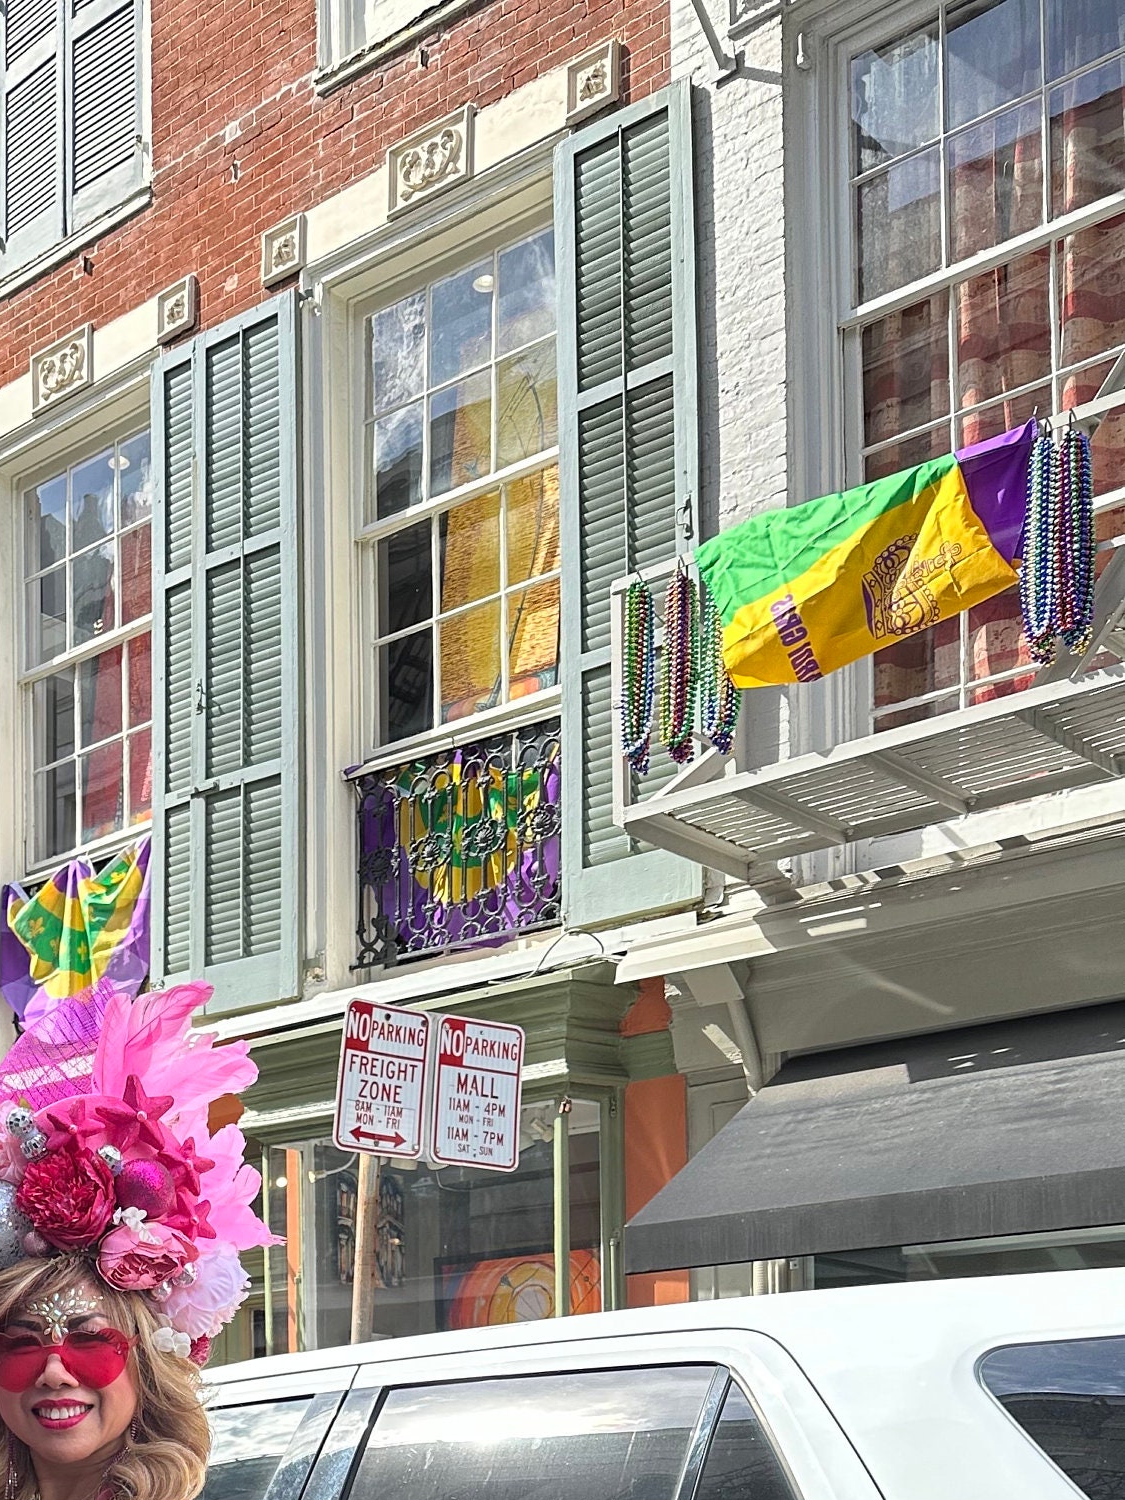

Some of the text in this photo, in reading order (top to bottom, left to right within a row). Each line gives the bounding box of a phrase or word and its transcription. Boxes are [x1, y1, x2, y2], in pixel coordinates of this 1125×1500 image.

[347, 1010, 424, 1047] NO PARKING
[440, 1028, 518, 1061] NO PARKING
[349, 1054, 418, 1083] FREIGHT
[358, 1079, 402, 1104] ZONE
[456, 1072, 499, 1099] MALL
[355, 1100, 372, 1113] 8AM
[384, 1105, 403, 1118] 11AM
[449, 1097, 470, 1112] 11AM
[484, 1103, 506, 1117] 4PM
[356, 1112, 374, 1126] MON
[386, 1117, 400, 1130] FRI
[459, 1114, 473, 1124] MON
[483, 1117, 494, 1127] FRI
[447, 1126, 468, 1141] 11AM
[483, 1131, 504, 1146] 7PM
[458, 1143, 470, 1153] SAT
[479, 1146, 493, 1156] SUN
